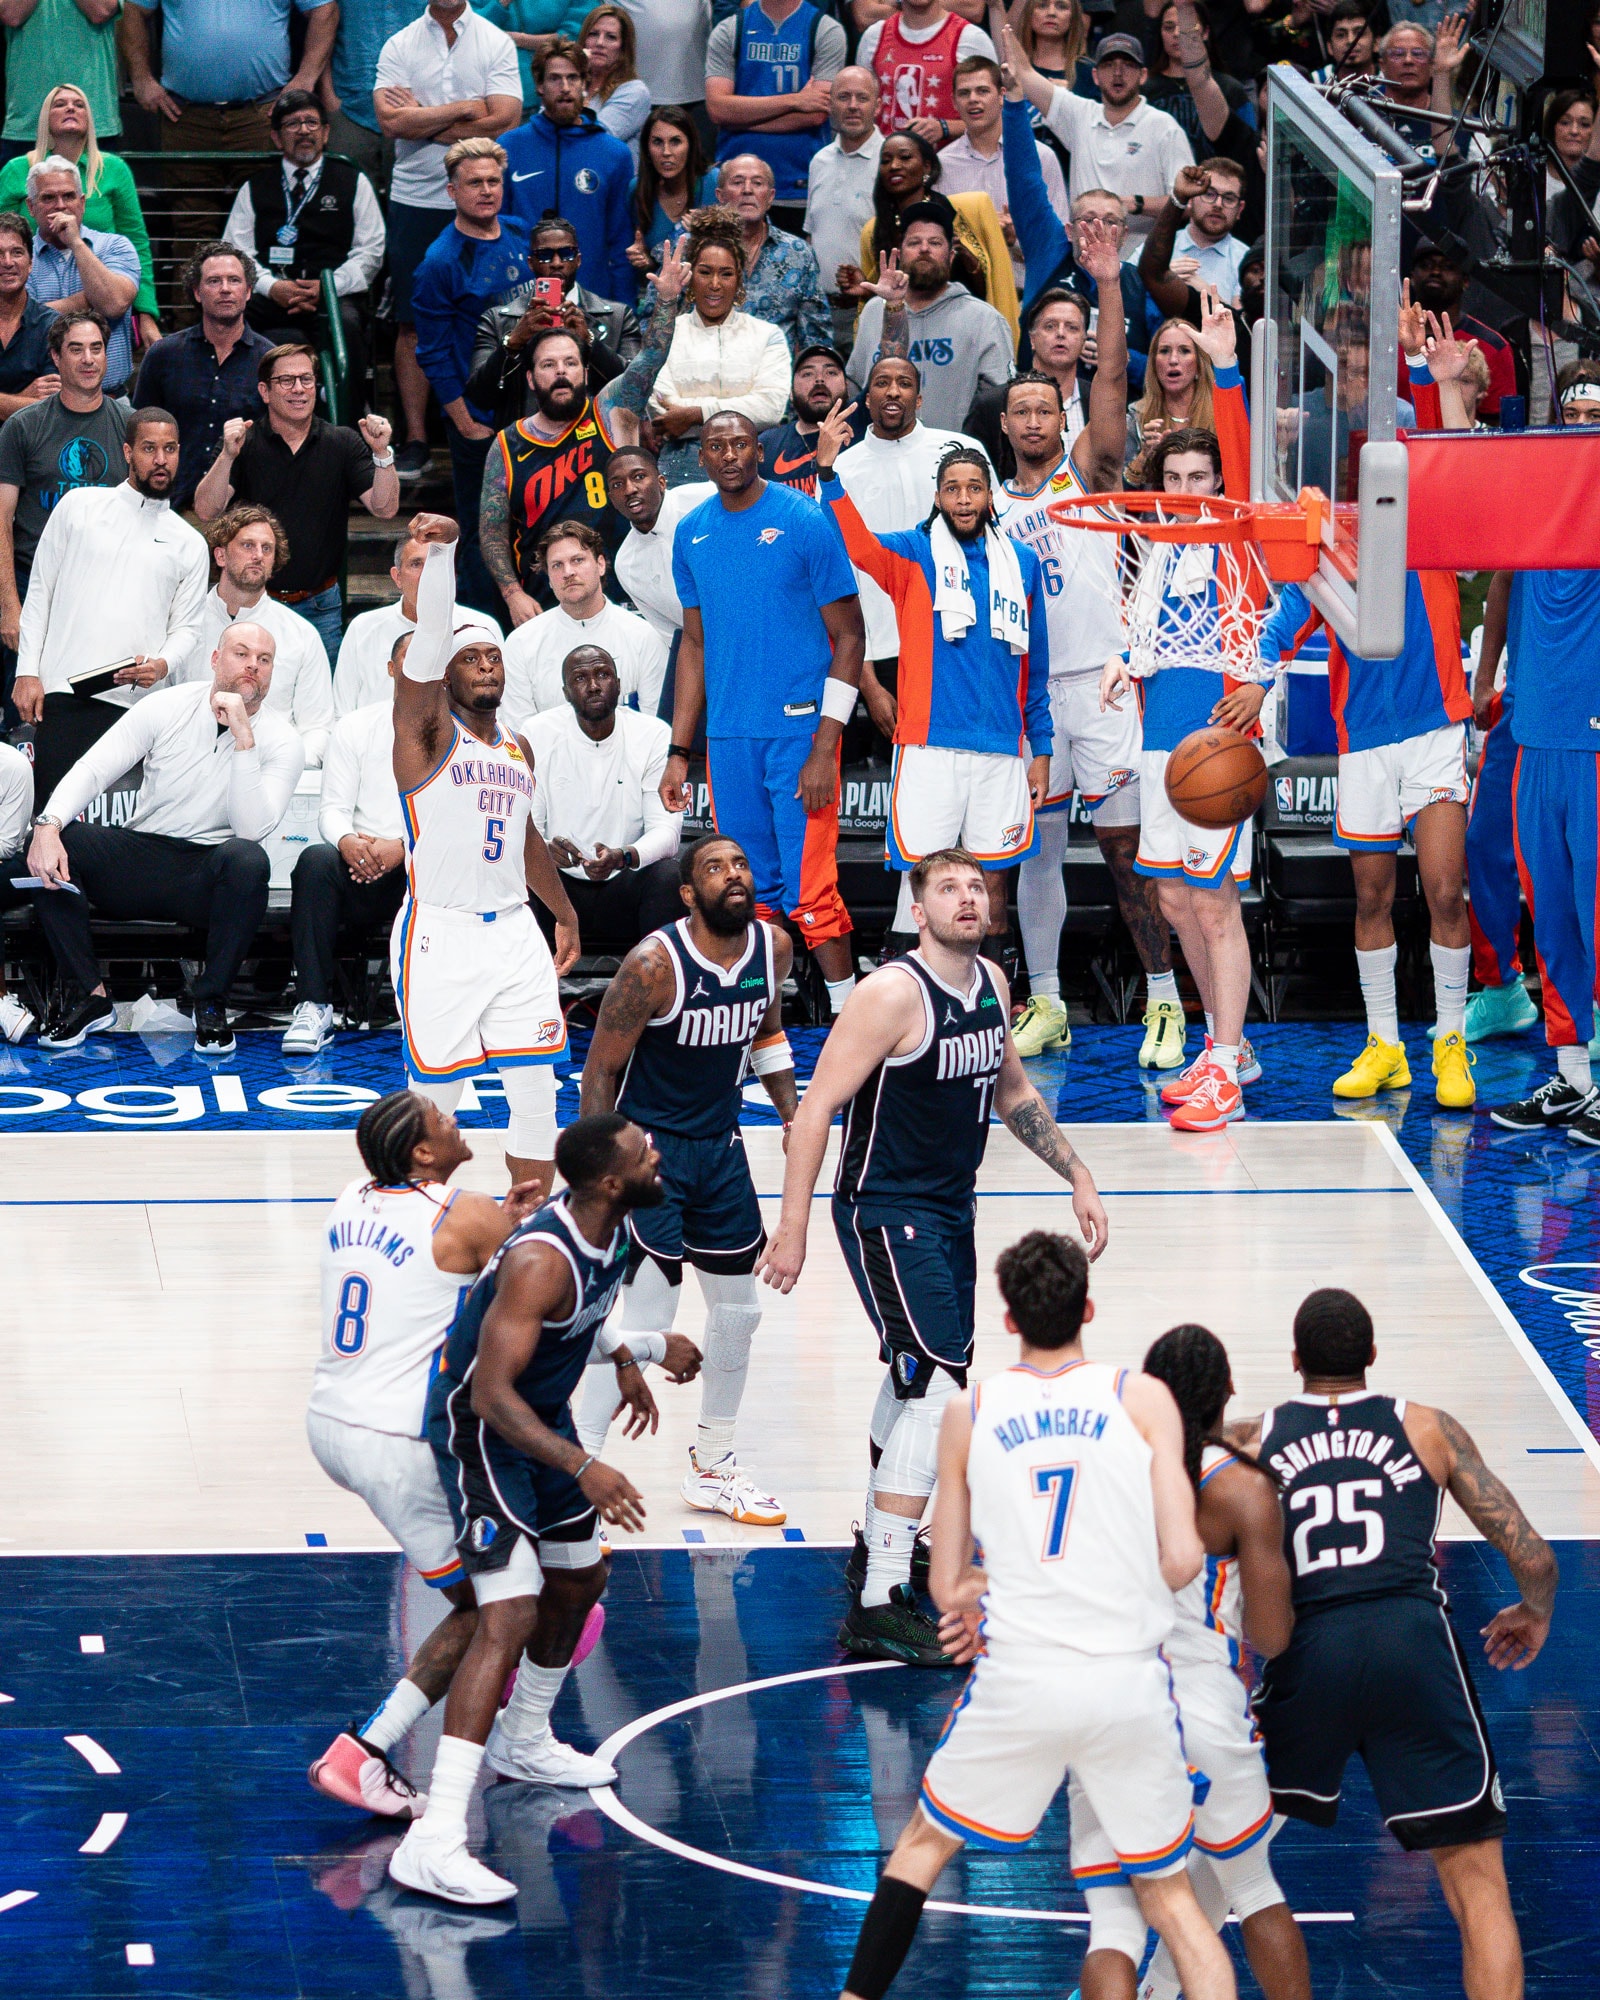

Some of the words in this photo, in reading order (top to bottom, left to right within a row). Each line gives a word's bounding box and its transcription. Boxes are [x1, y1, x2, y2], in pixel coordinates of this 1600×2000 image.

[872, 337, 955, 367] AVS
[524, 440, 593, 529] OKC
[1037, 556, 1064, 600] 6
[451, 761, 536, 801] OKLAHOMA
[477, 789, 516, 816] CITY
[87, 789, 140, 828] PLAY
[854, 818, 885, 830] Google
[482, 816, 507, 864] 5
[740, 976, 765, 989] chime
[980, 996, 998, 1009] chime
[326, 1219, 416, 1268] WILLIAMS
[331, 1271, 374, 1360] 8
[993, 1407, 1109, 1453] HOLMGREN
[1269, 1429, 1395, 1482] SHINGTON
[1383, 1452, 1422, 1492] JR.
[1028, 1460, 1081, 1563] 7
[1289, 1479, 1385, 1577] 25
